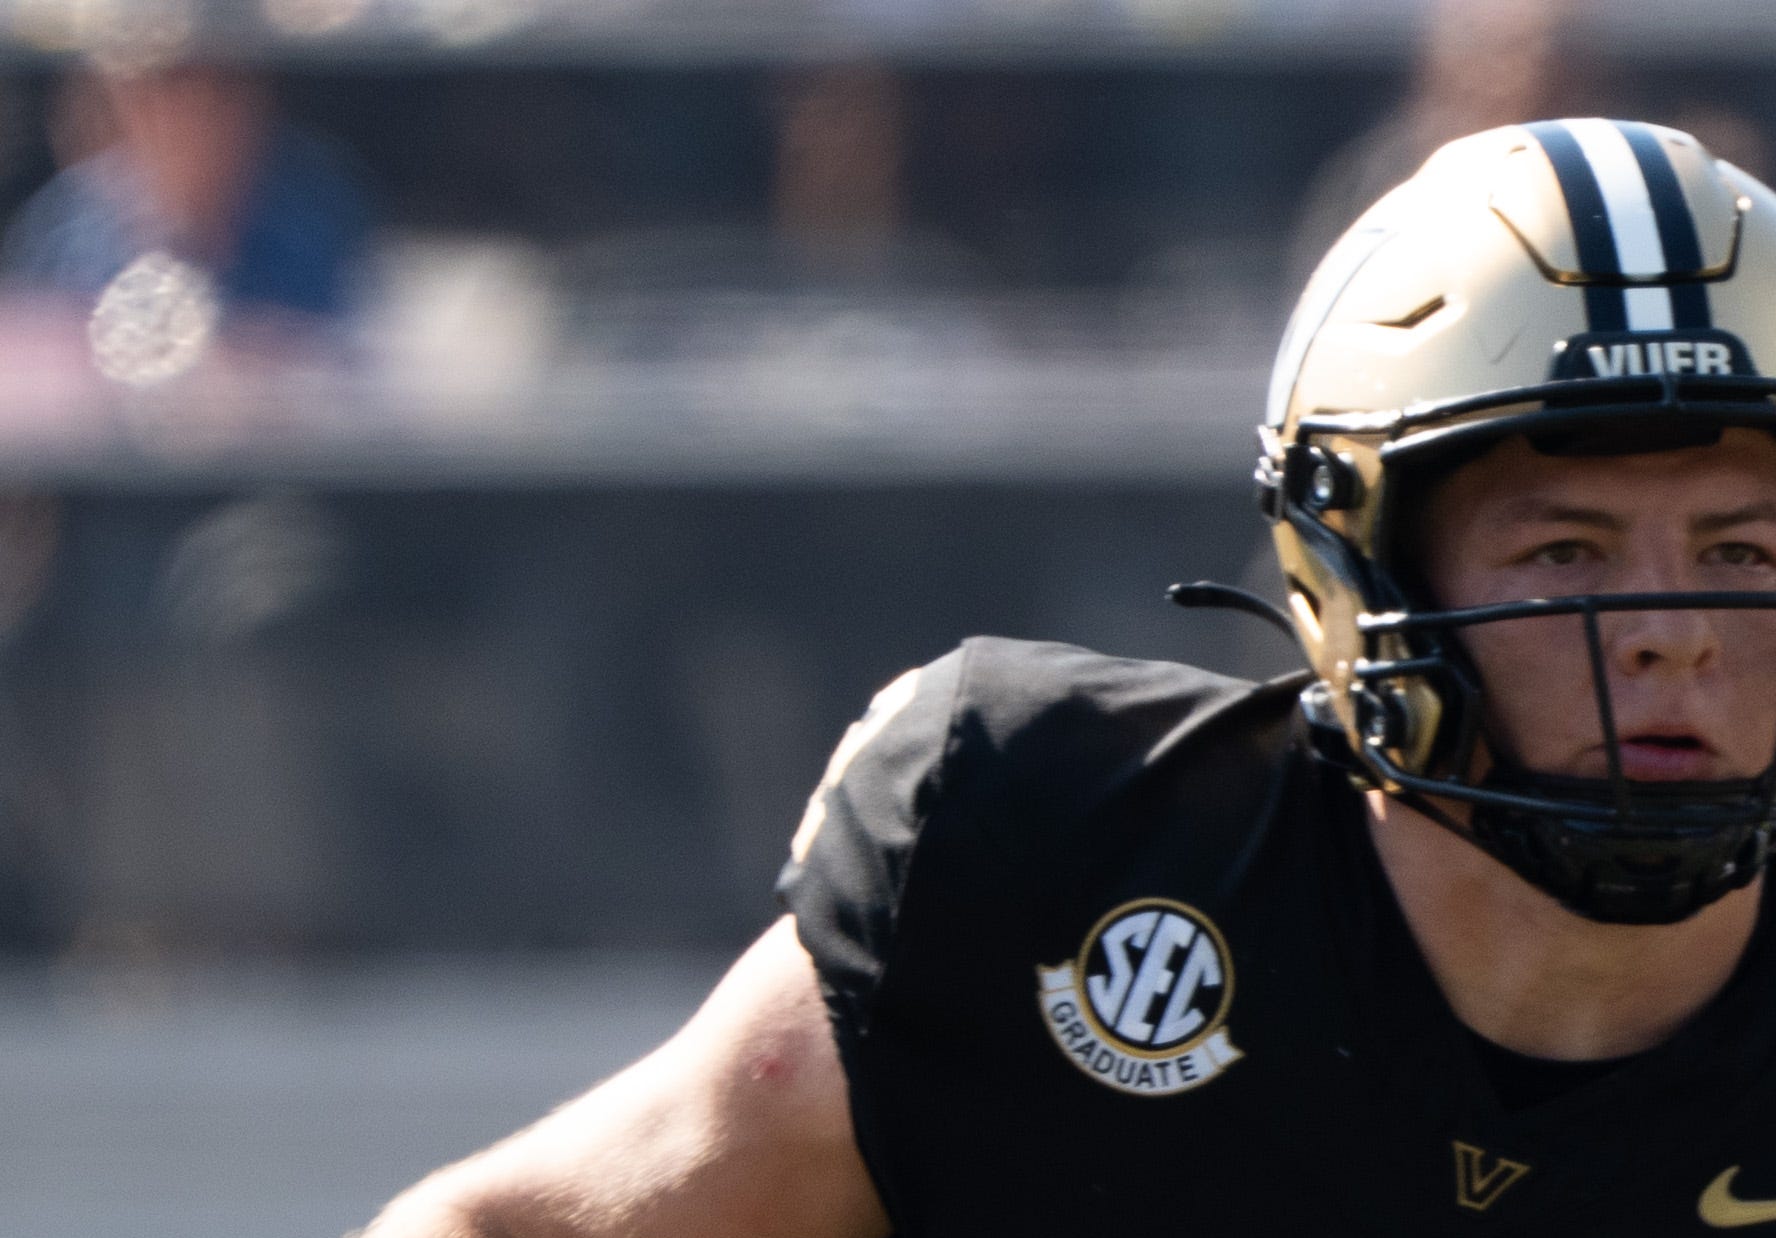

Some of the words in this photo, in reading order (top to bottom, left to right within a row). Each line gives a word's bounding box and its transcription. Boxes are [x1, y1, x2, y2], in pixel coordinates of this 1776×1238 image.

[1087, 911, 1224, 1045] SEC
[1051, 1001, 1199, 1088] GRADUATE
[1453, 1141, 1531, 1210] V
